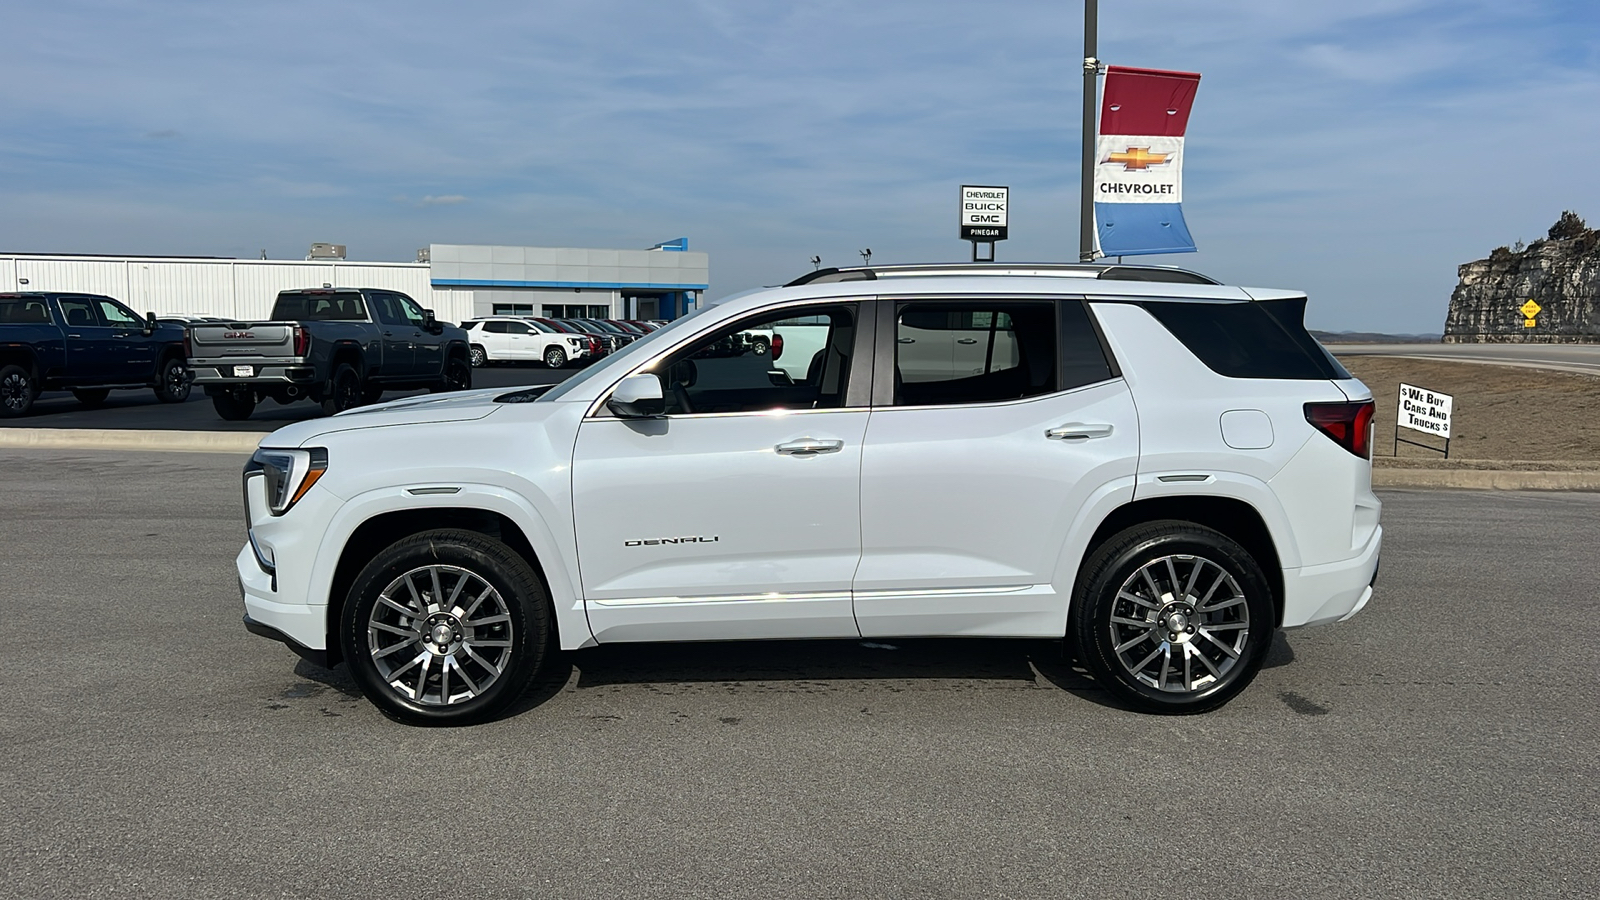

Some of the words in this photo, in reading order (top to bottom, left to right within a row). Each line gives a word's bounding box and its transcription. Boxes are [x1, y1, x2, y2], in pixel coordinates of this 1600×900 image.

[1100, 183, 1173, 194] CHEVROLET
[966, 191, 1005, 199] CHEVROLET
[965, 203, 1005, 211] BUICK
[970, 215, 1000, 223] GMC
[970, 228, 999, 236] PINEGAR
[624, 536, 719, 547] DENALI
